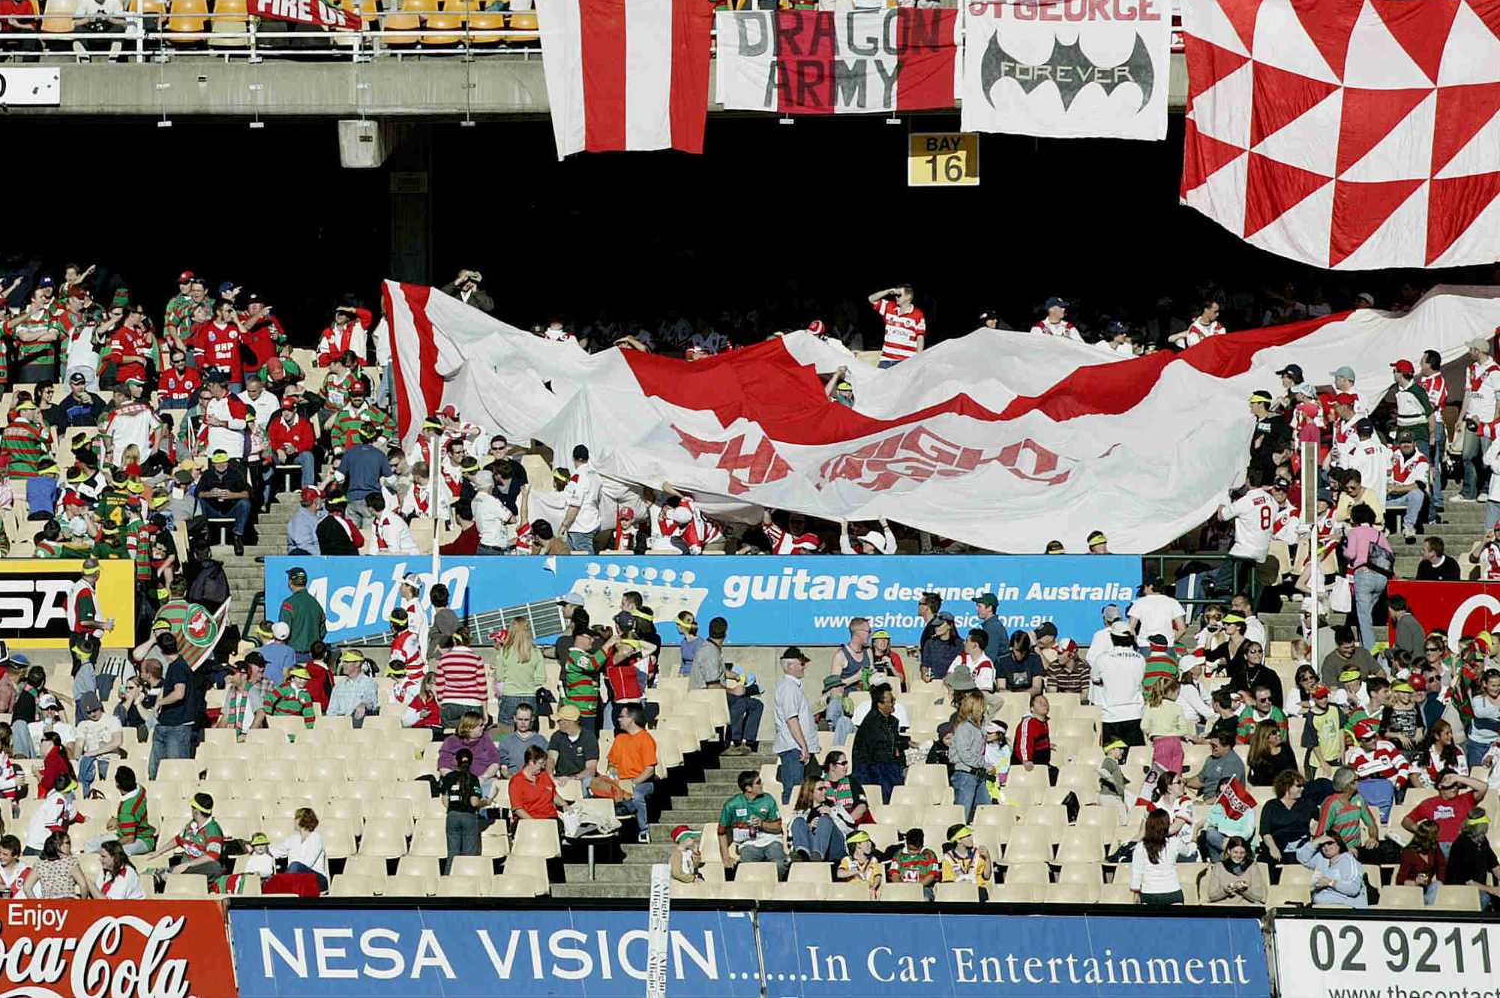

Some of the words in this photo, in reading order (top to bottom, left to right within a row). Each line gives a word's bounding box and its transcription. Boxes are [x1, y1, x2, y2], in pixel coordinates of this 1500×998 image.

[739, 8, 941, 57] DRAGON
[764, 59, 906, 109] ARMY
[1001, 62, 1134, 84] FOREVER
[925, 137, 961, 151] BAY
[924, 153, 963, 183] 16
[1260, 506, 1271, 530] 8
[723, 568, 879, 608] guitars
[998, 583, 1019, 601] in
[1025, 582, 1132, 601] Australia
[8, 903, 68, 931] Enjoy
[259, 928, 457, 978] NESA
[476, 929, 719, 980] VISION
[867, 947, 937, 983] Car
[951, 947, 1251, 984] Entertainment
[1310, 924, 1366, 971] 02
[1383, 926, 1492, 973] 9211
